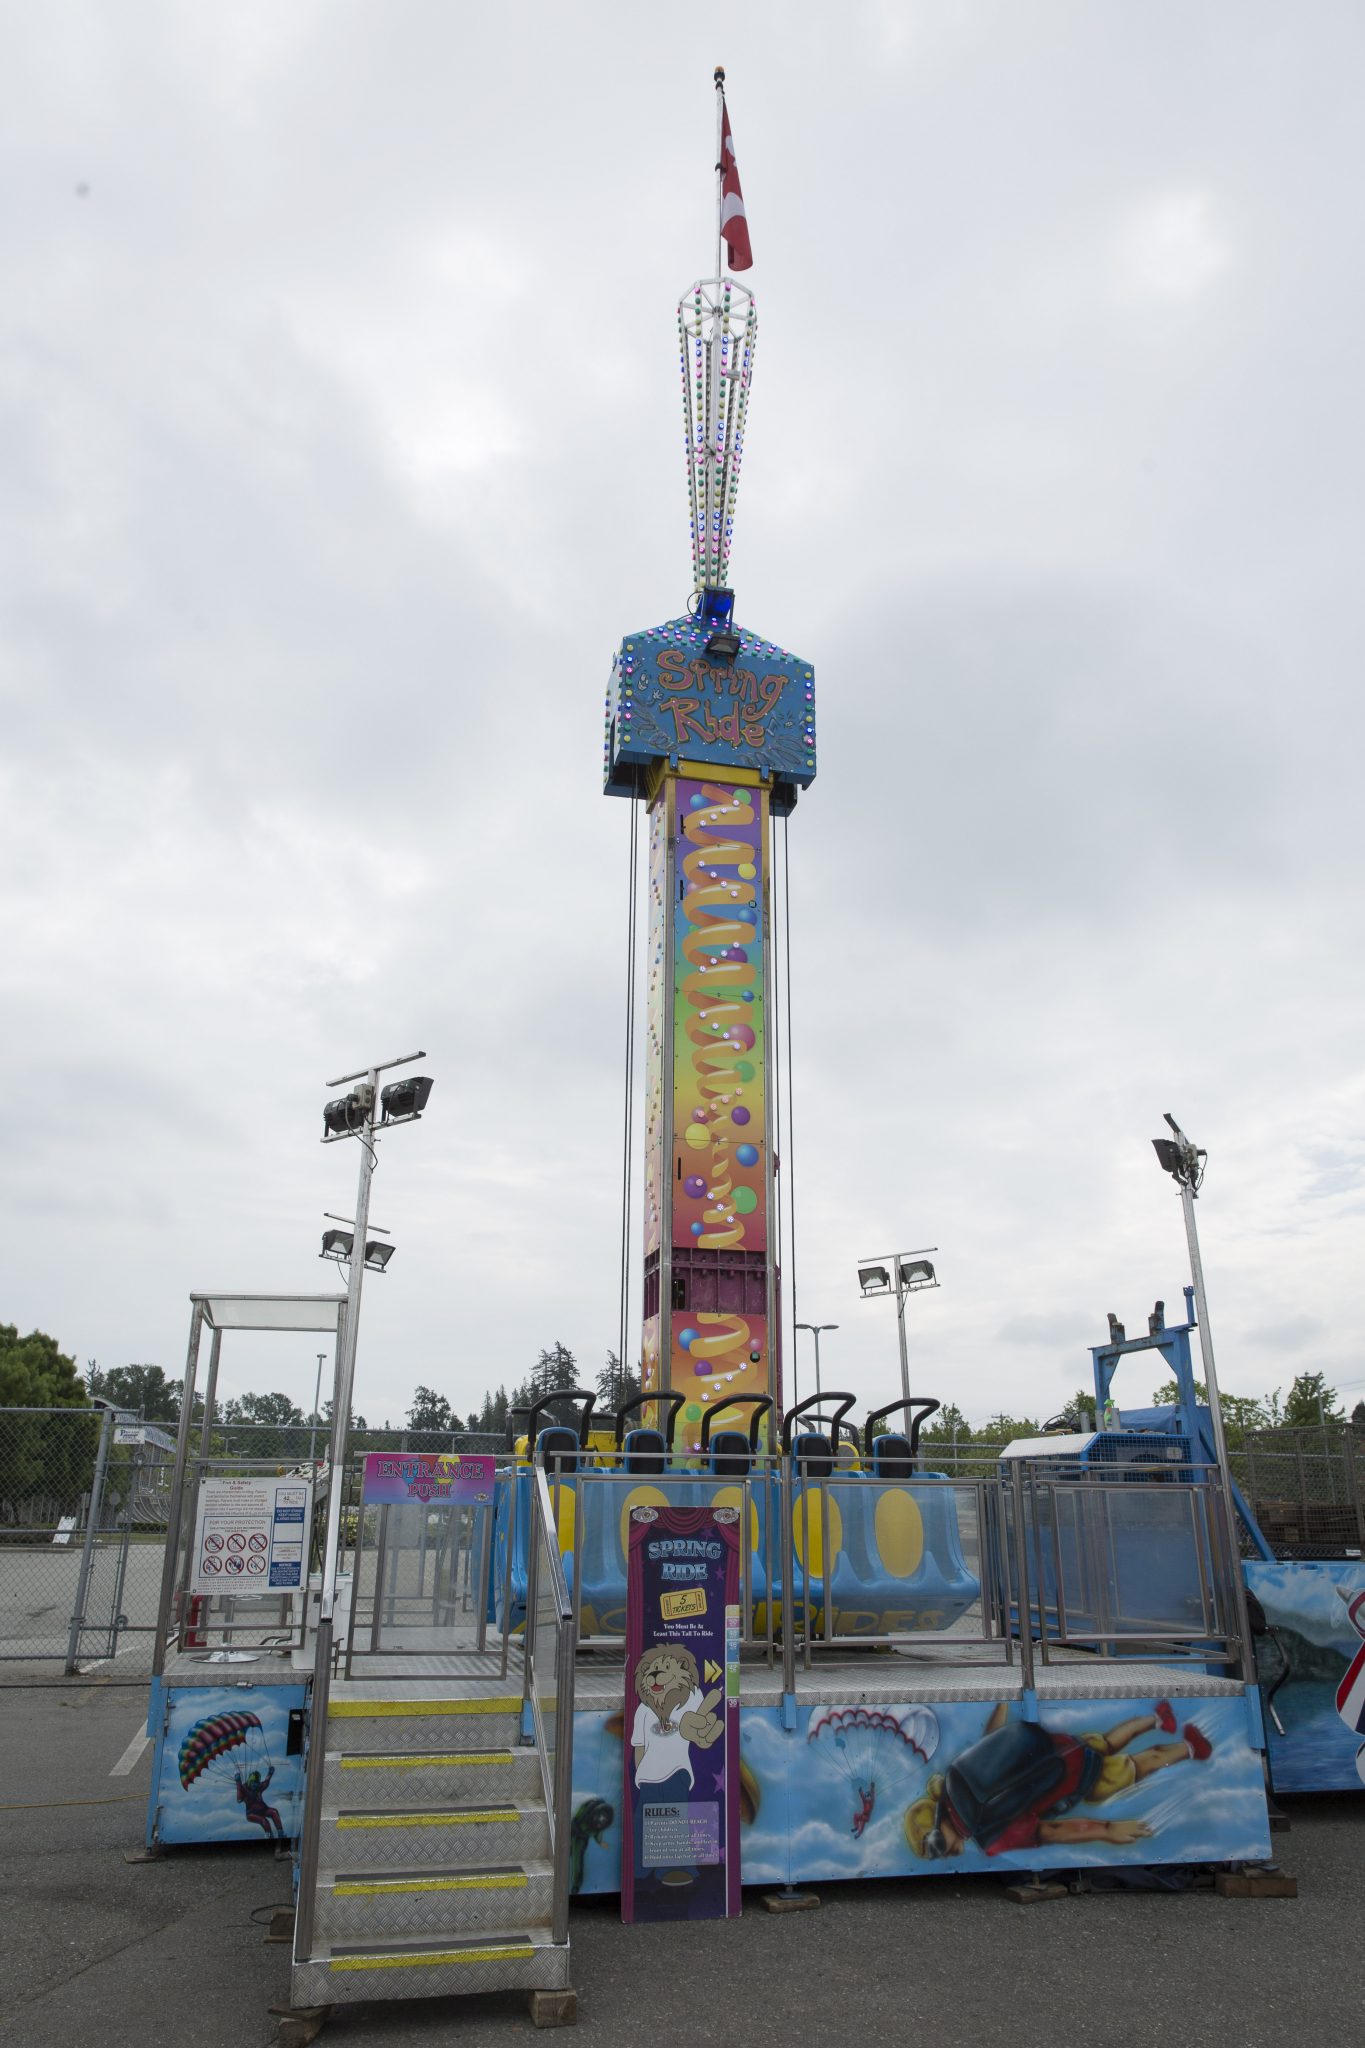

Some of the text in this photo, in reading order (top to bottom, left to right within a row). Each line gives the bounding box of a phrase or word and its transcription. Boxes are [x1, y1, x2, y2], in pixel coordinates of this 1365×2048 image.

[656, 650, 789, 722] Spring
[659, 697, 765, 747] Ride
[377, 1460, 484, 1479] ENTRANCE
[408, 1483, 451, 1498] PUSH
[647, 1540, 721, 1559] SPRING
[661, 1562, 708, 1580] RIDE
[679, 1594, 687, 1604] 5
[672, 1603, 697, 1614] TICKETS
[644, 1807, 680, 1817] RULES:
